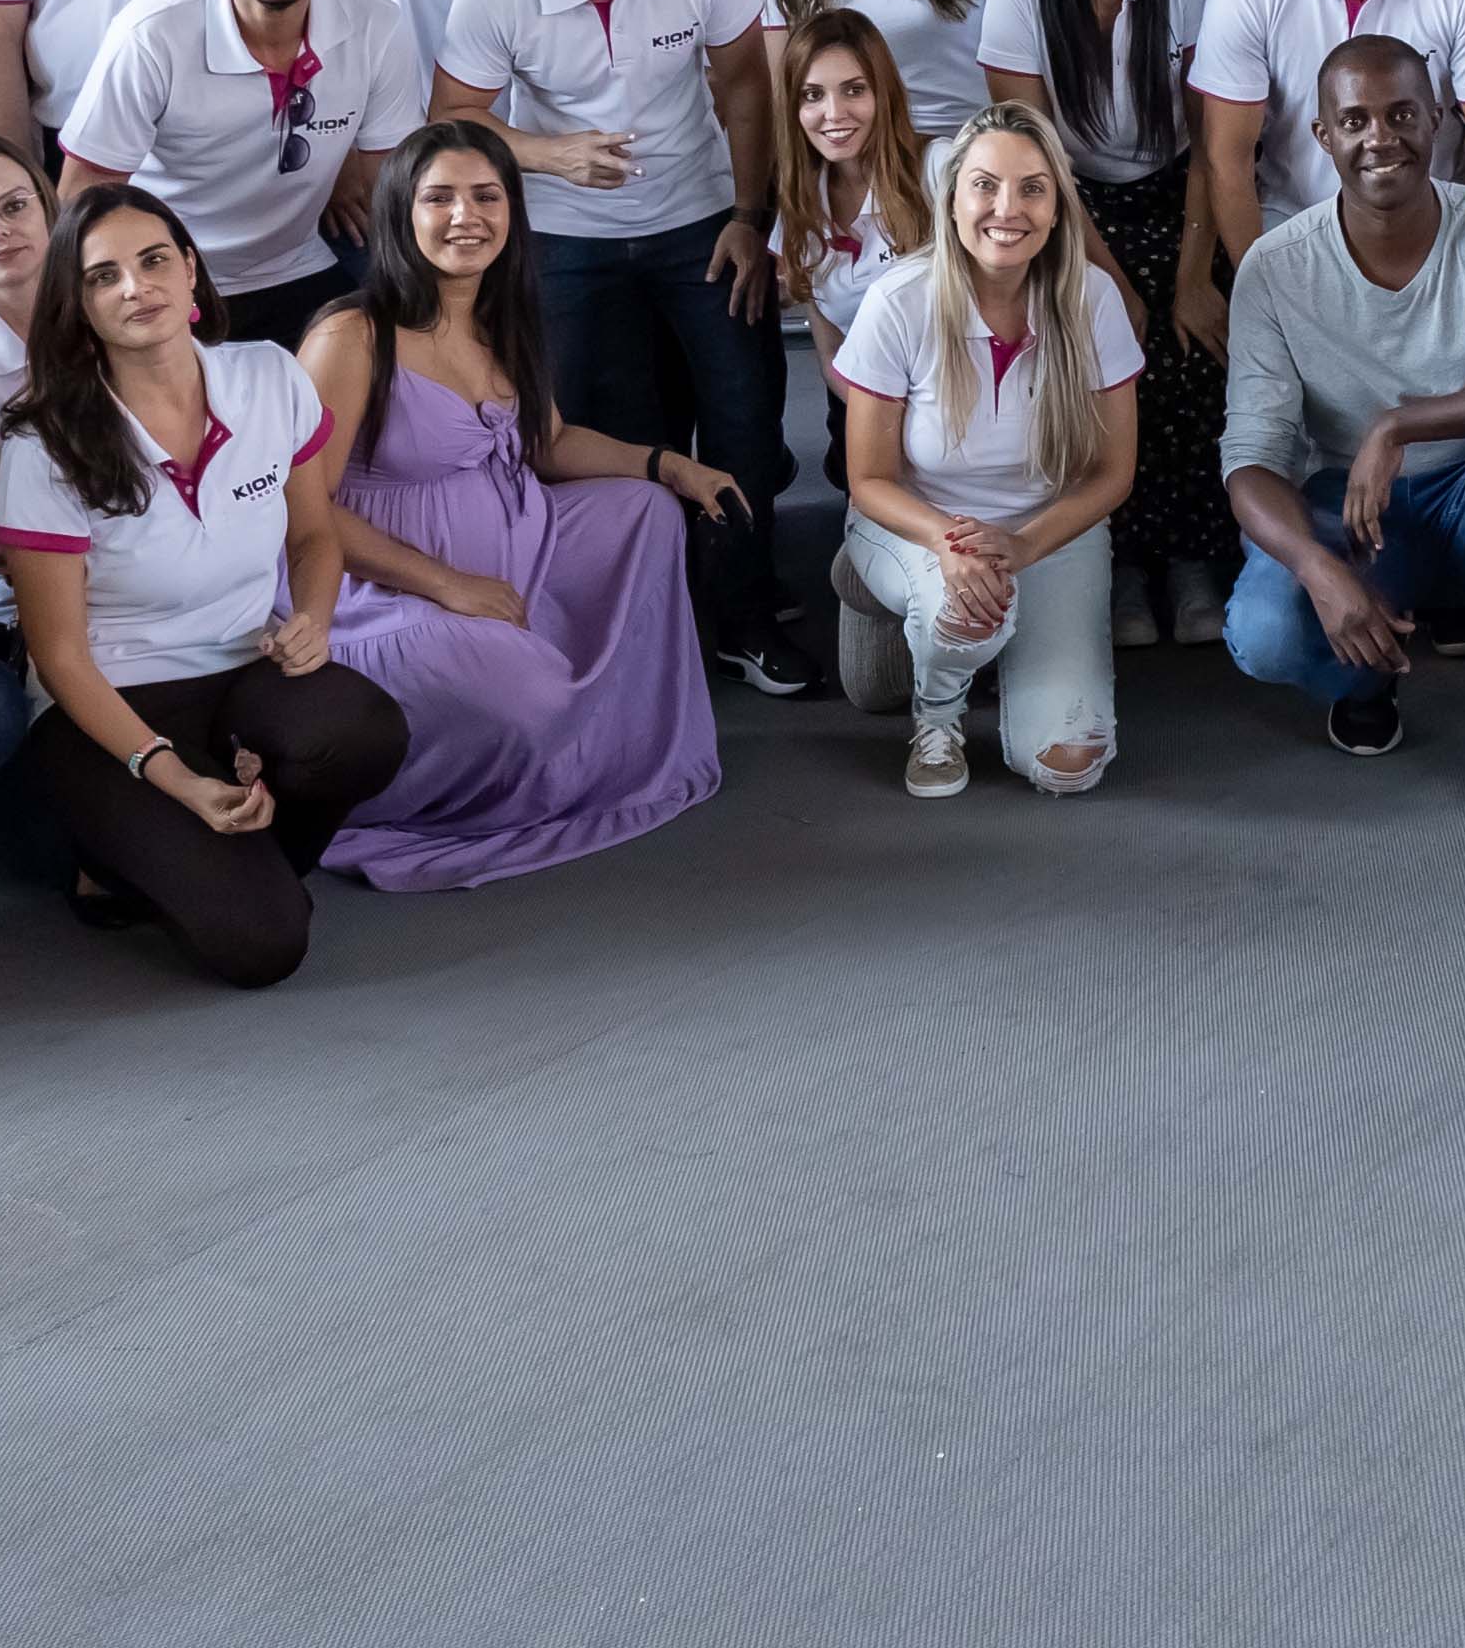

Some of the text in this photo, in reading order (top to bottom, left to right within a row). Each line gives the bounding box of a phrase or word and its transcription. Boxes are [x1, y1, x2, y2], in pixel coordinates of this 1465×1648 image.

[652, 28, 695, 47] KION
[306, 116, 349, 131] KION
[232, 471, 278, 501] KION
